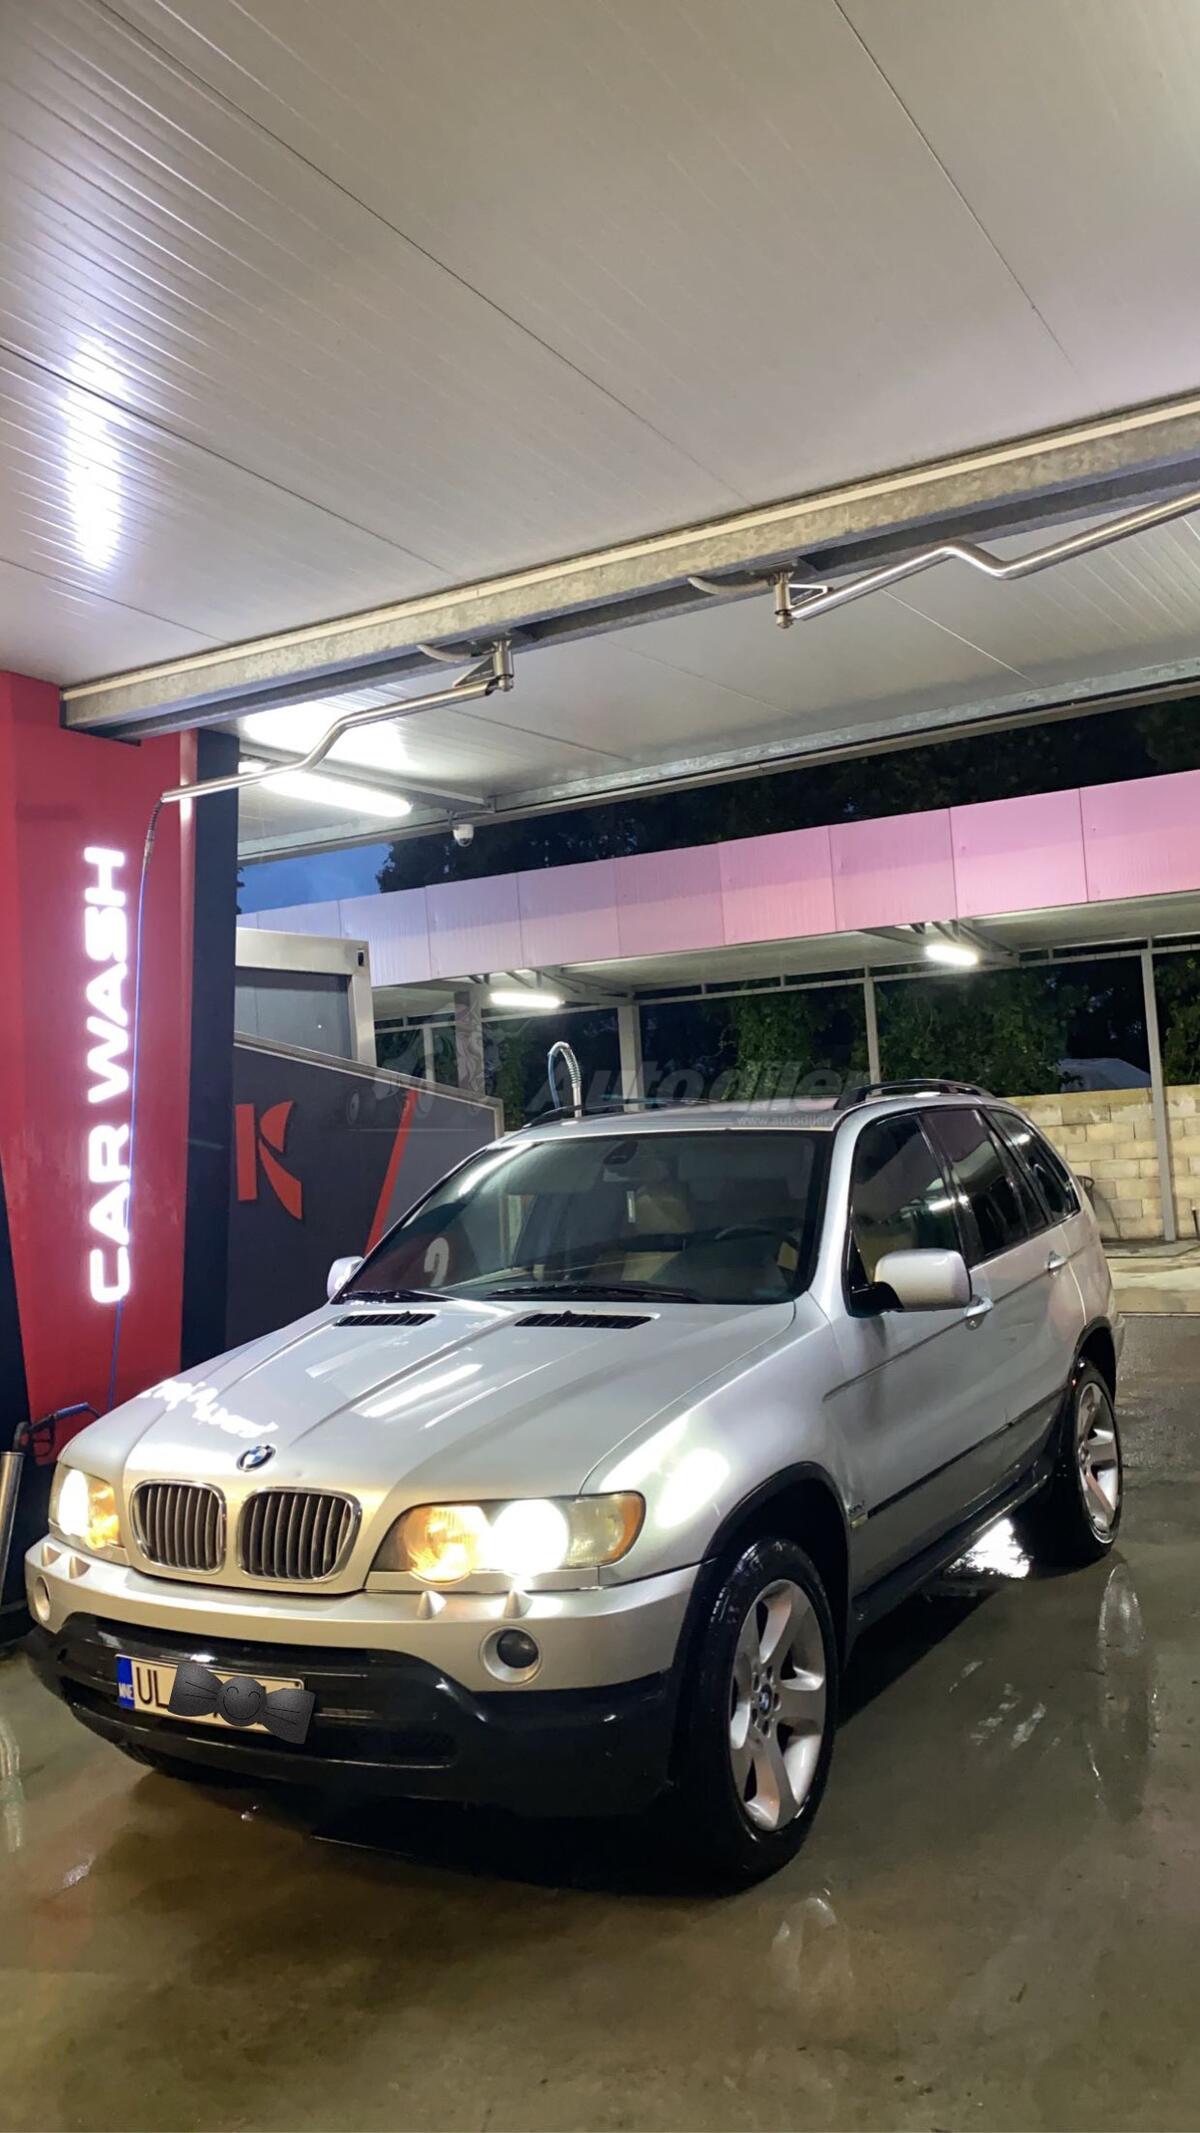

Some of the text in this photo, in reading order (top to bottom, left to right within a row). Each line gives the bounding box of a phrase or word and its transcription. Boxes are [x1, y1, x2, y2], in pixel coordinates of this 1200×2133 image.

[84, 847, 131, 1303] CAR WASH
[136, 1666, 169, 1709] UL
